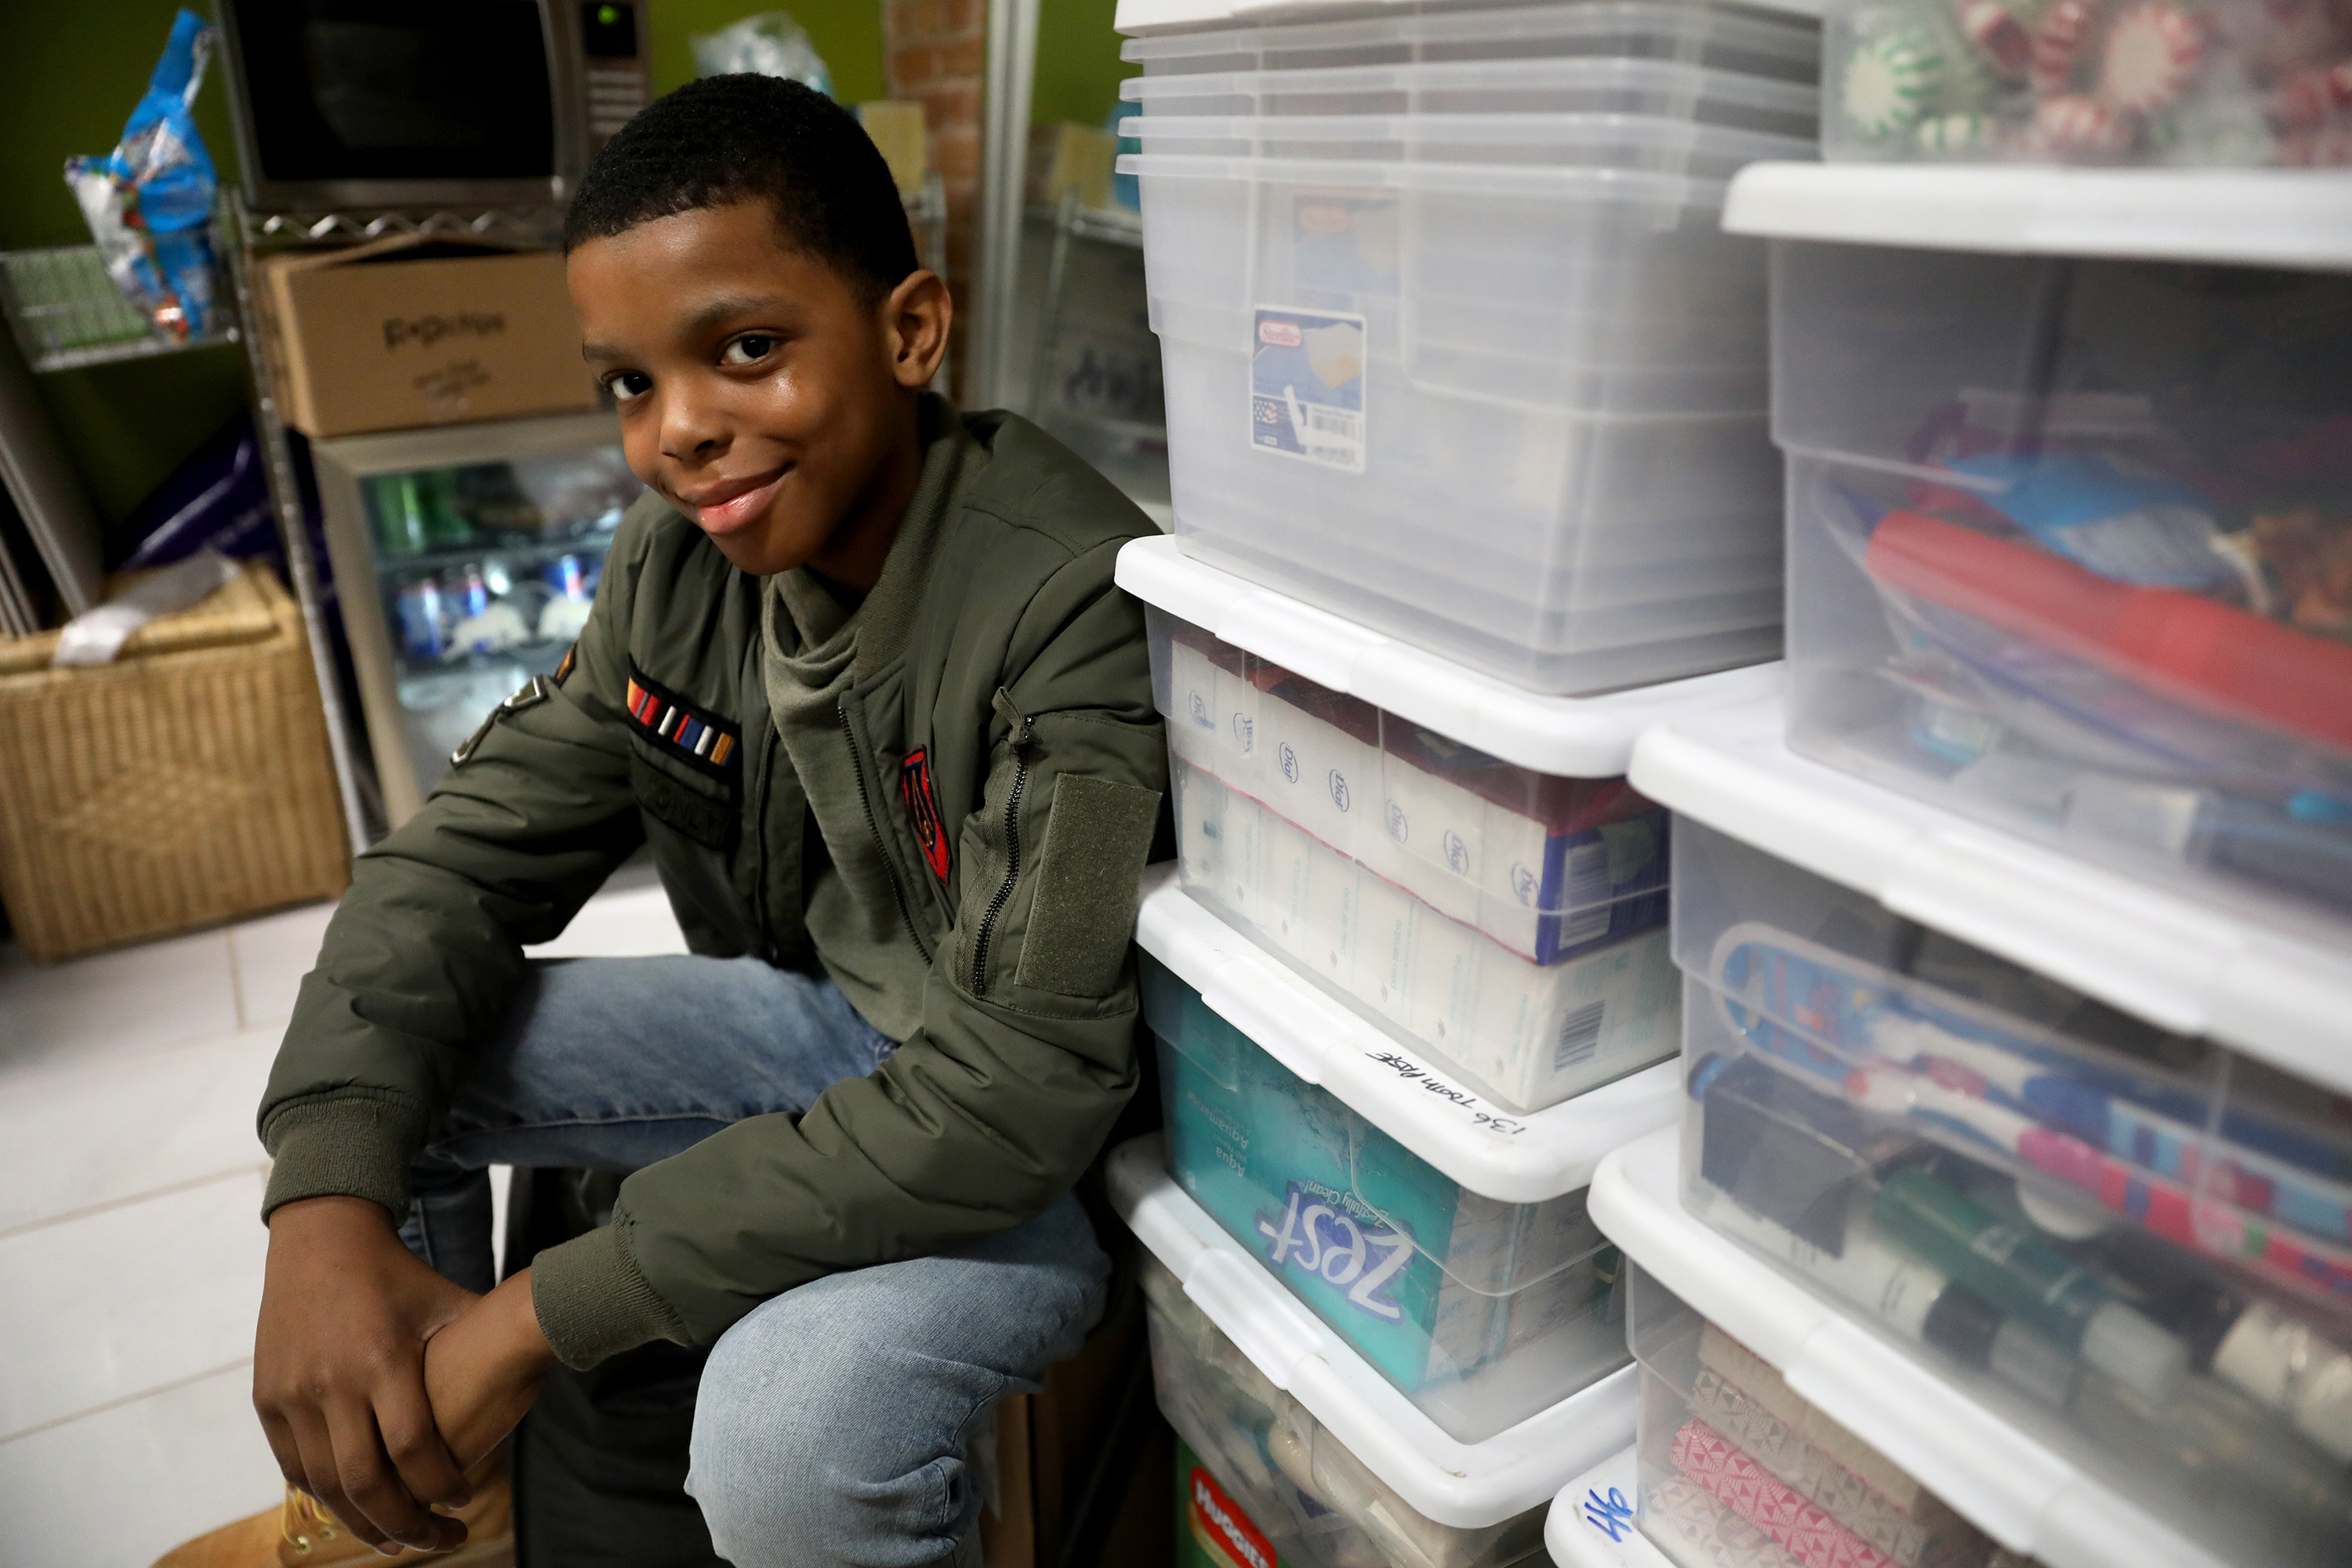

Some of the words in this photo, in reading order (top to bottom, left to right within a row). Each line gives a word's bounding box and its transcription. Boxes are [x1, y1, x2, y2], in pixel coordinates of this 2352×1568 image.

[1421, 1078, 1476, 1109] TOOTH
[1473, 1112, 1526, 1134] 136
[1215, 1145, 1246, 1178] Aqua
[1303, 1179, 1341, 1205] Clean!
[1341, 1191, 1390, 1229] Zestfully
[1259, 1192, 1414, 1319] Zest
[1584, 1486, 1634, 1543] 46
